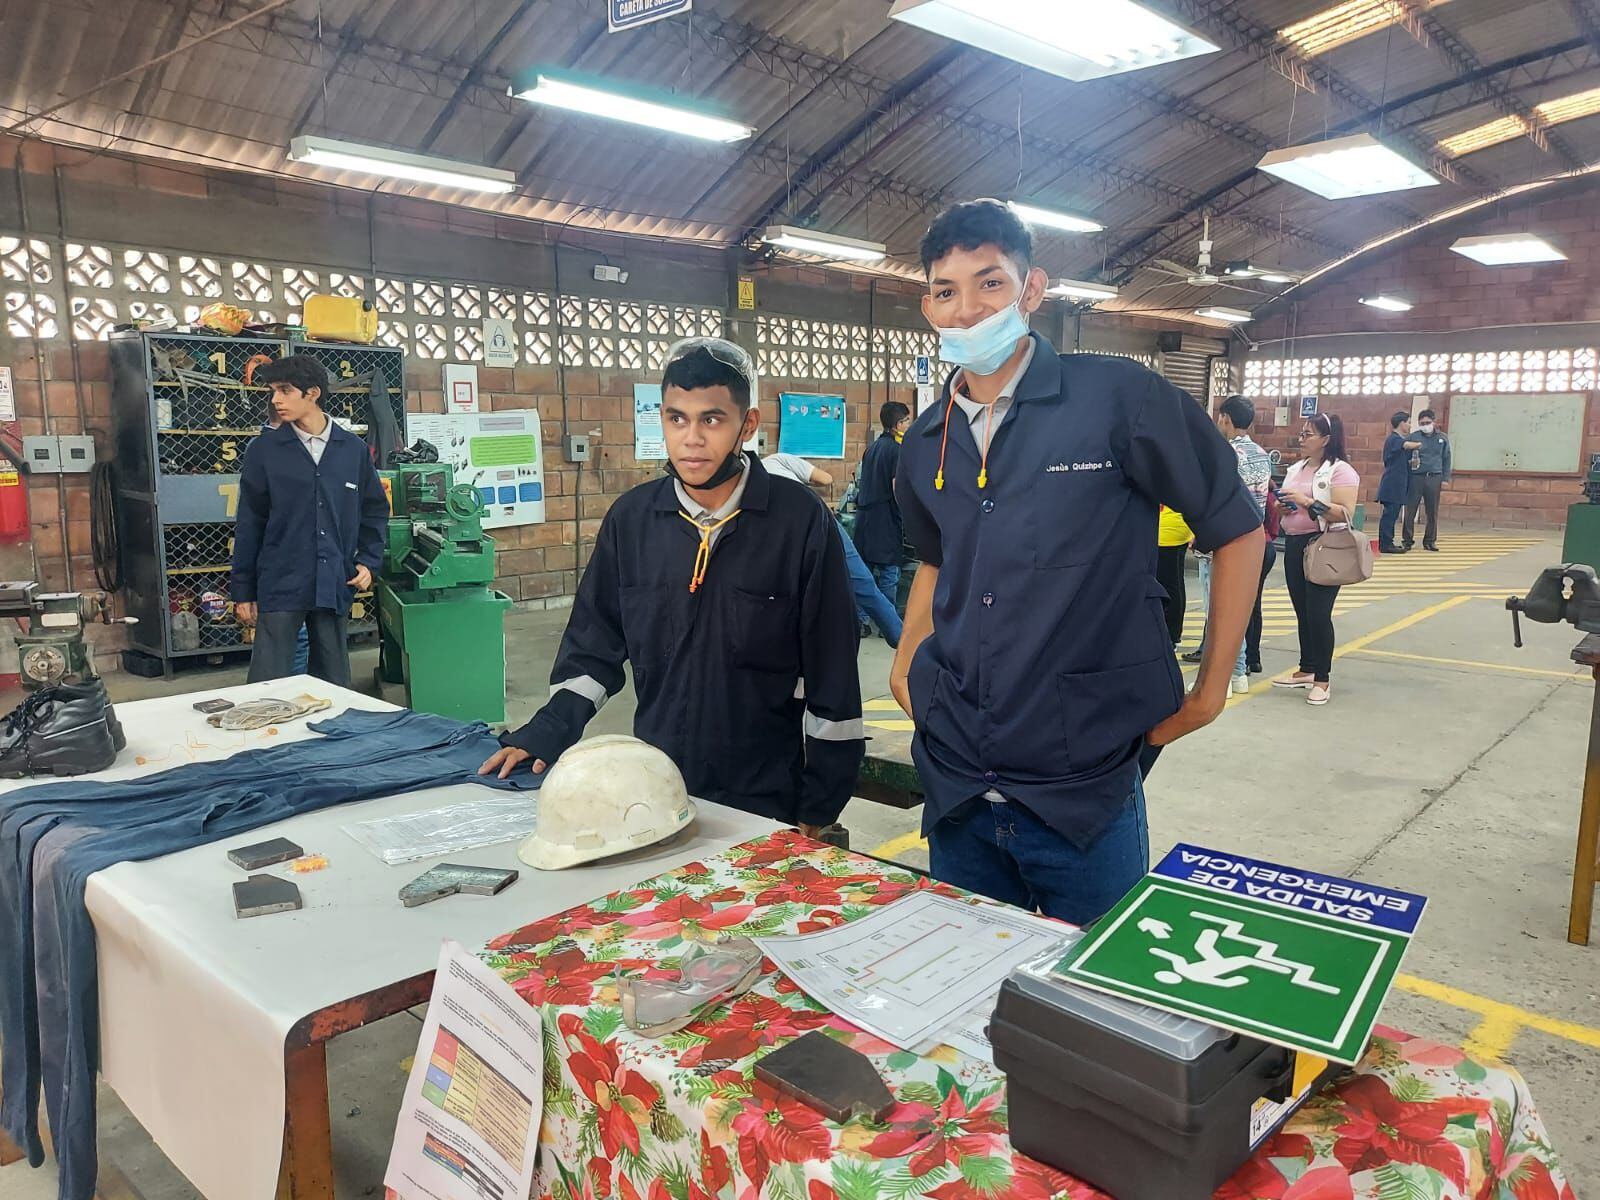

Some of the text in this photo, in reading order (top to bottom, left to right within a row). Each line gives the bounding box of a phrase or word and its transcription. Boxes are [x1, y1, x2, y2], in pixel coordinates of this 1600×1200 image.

[619, 0, 643, 16] CARETA
[209, 352, 226, 374] 1
[340, 360, 354, 377] 2
[215, 402, 226, 419] 3
[343, 401, 353, 416] 4
[222, 441, 237, 461] 5
[1181, 850, 1411, 912] EMERGENCIA
[1187, 869, 1375, 922] SALIDA DE
